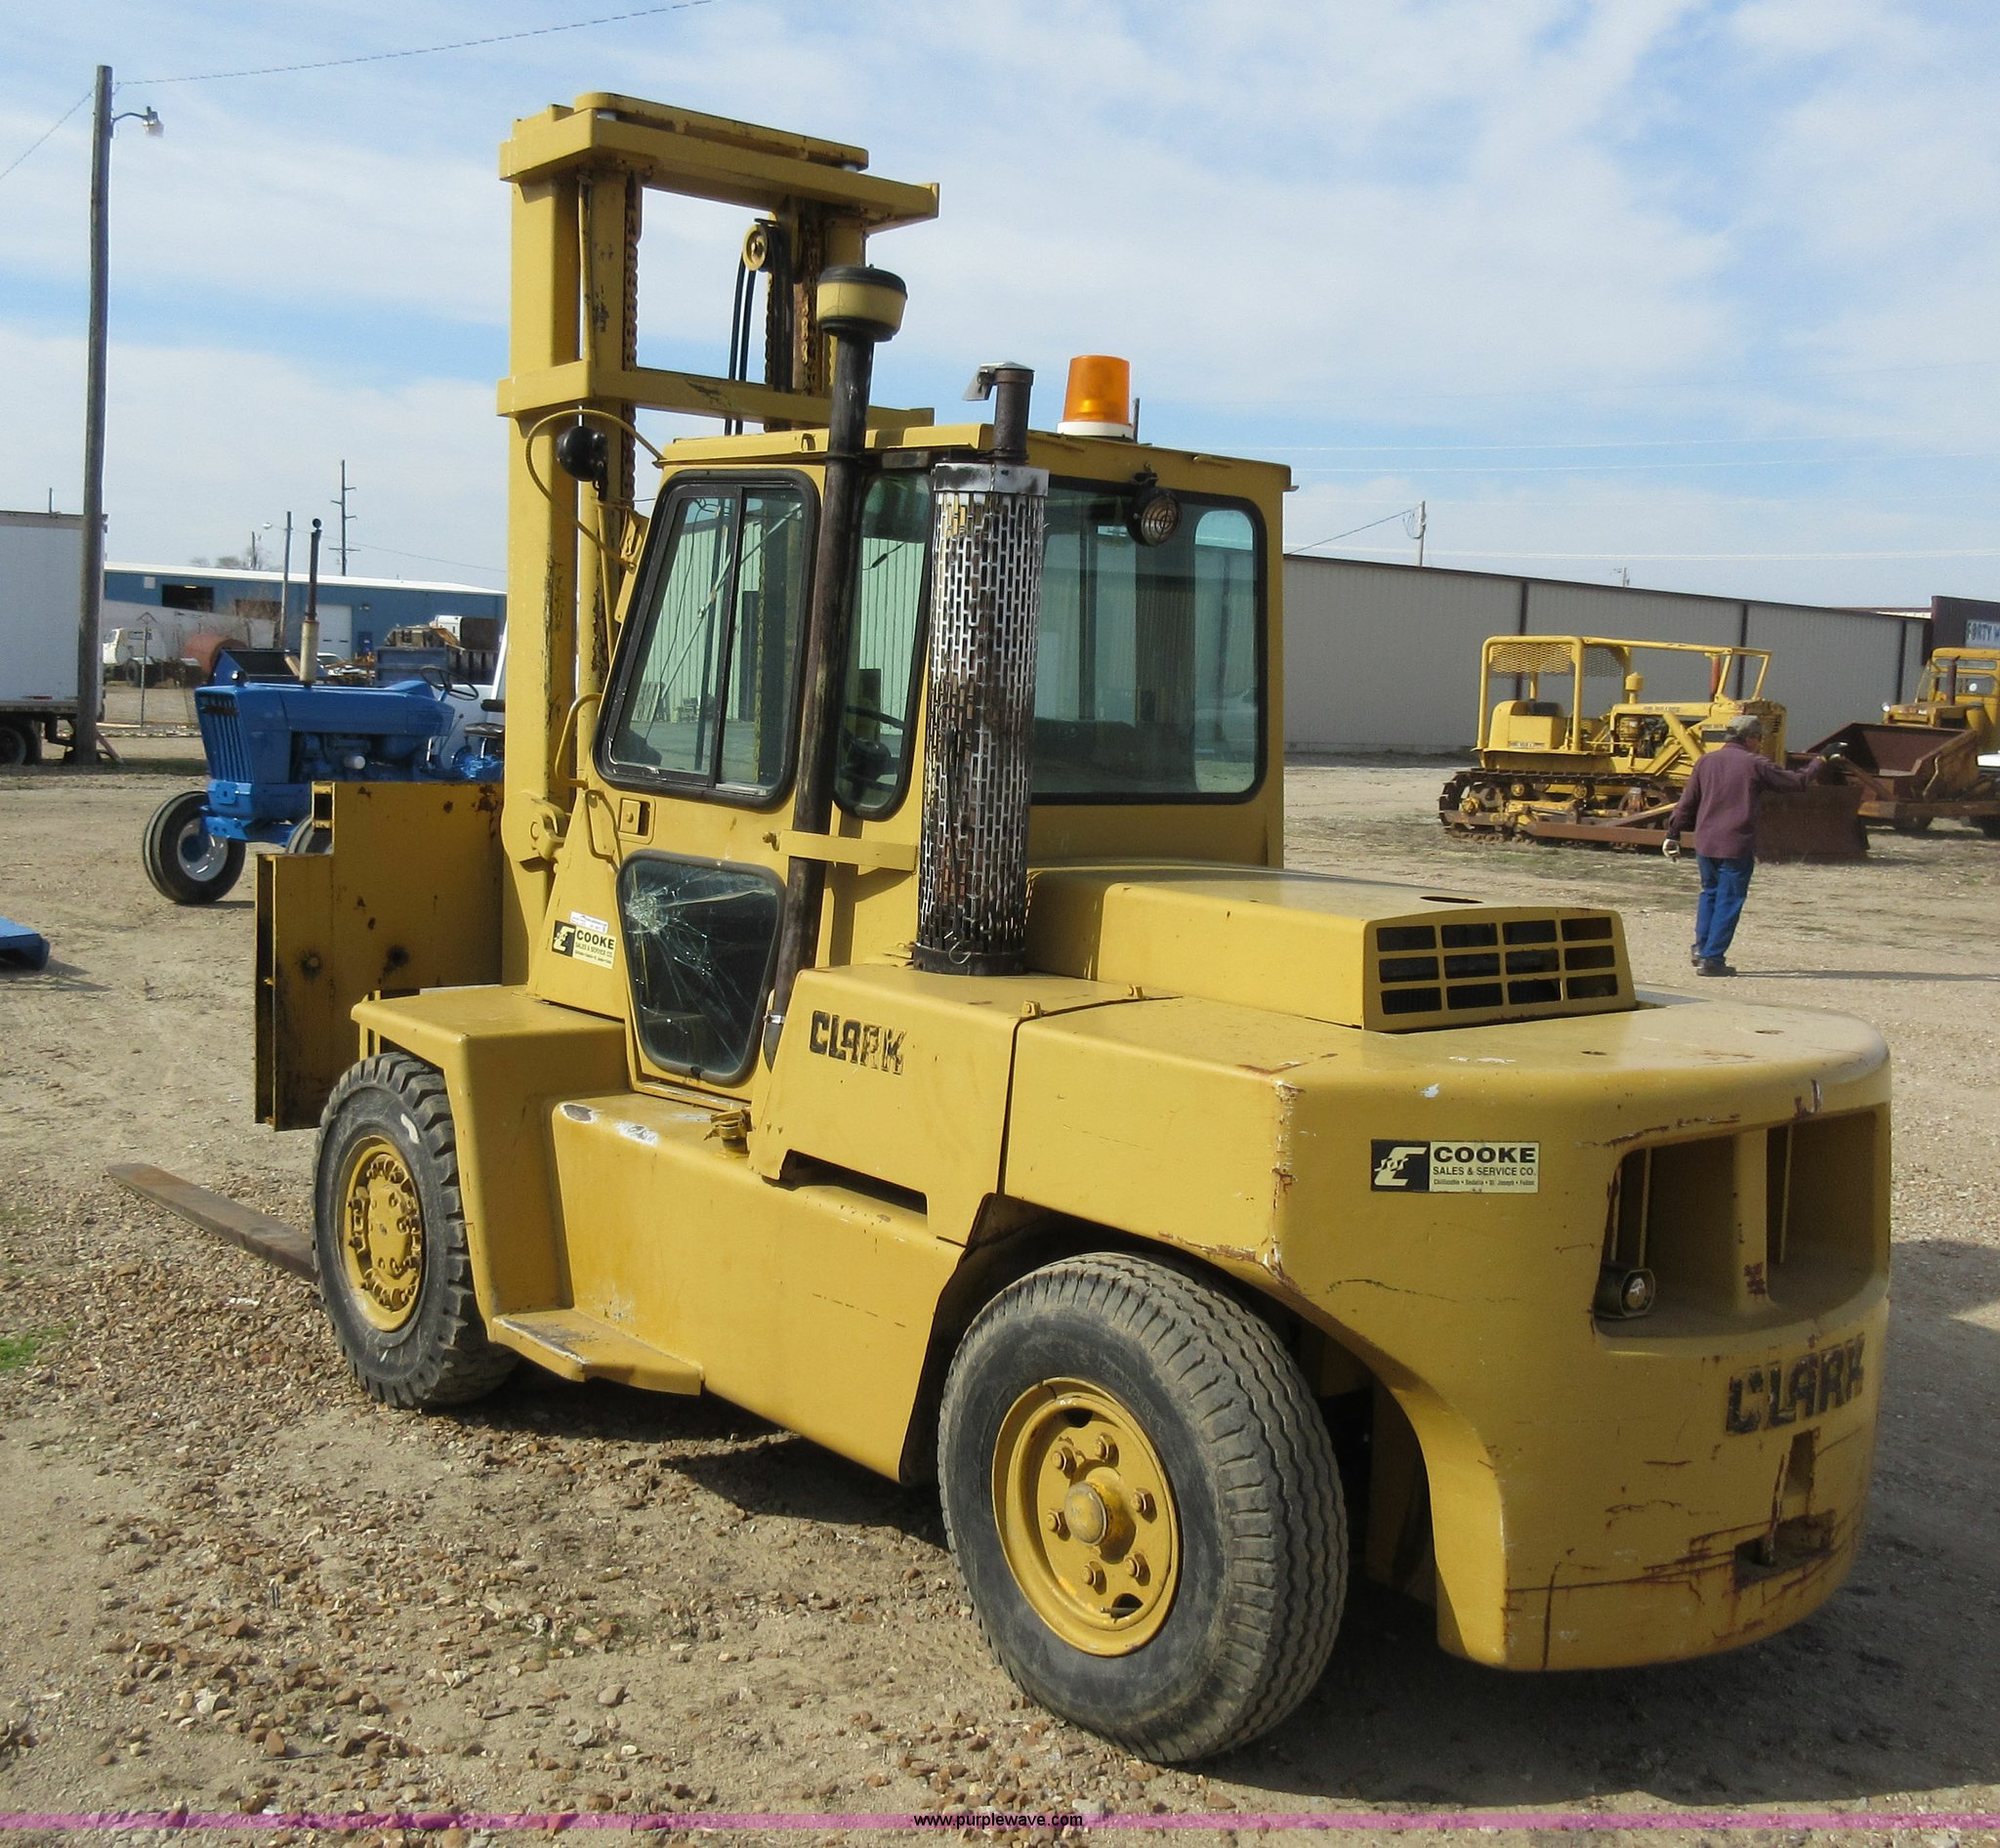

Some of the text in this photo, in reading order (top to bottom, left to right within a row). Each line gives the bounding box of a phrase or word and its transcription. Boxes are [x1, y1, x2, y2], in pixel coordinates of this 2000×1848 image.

[576, 930, 615, 950] COOKE
[810, 1009, 906, 1075] CLARK
[1434, 1146, 1536, 1163] COOKE
[1433, 1166, 1465, 1176] SALES
[1476, 1166, 1518, 1176] SERVICE
[1520, 1167, 1536, 1176] CO.
[1726, 1331, 1865, 1434] CLARK
